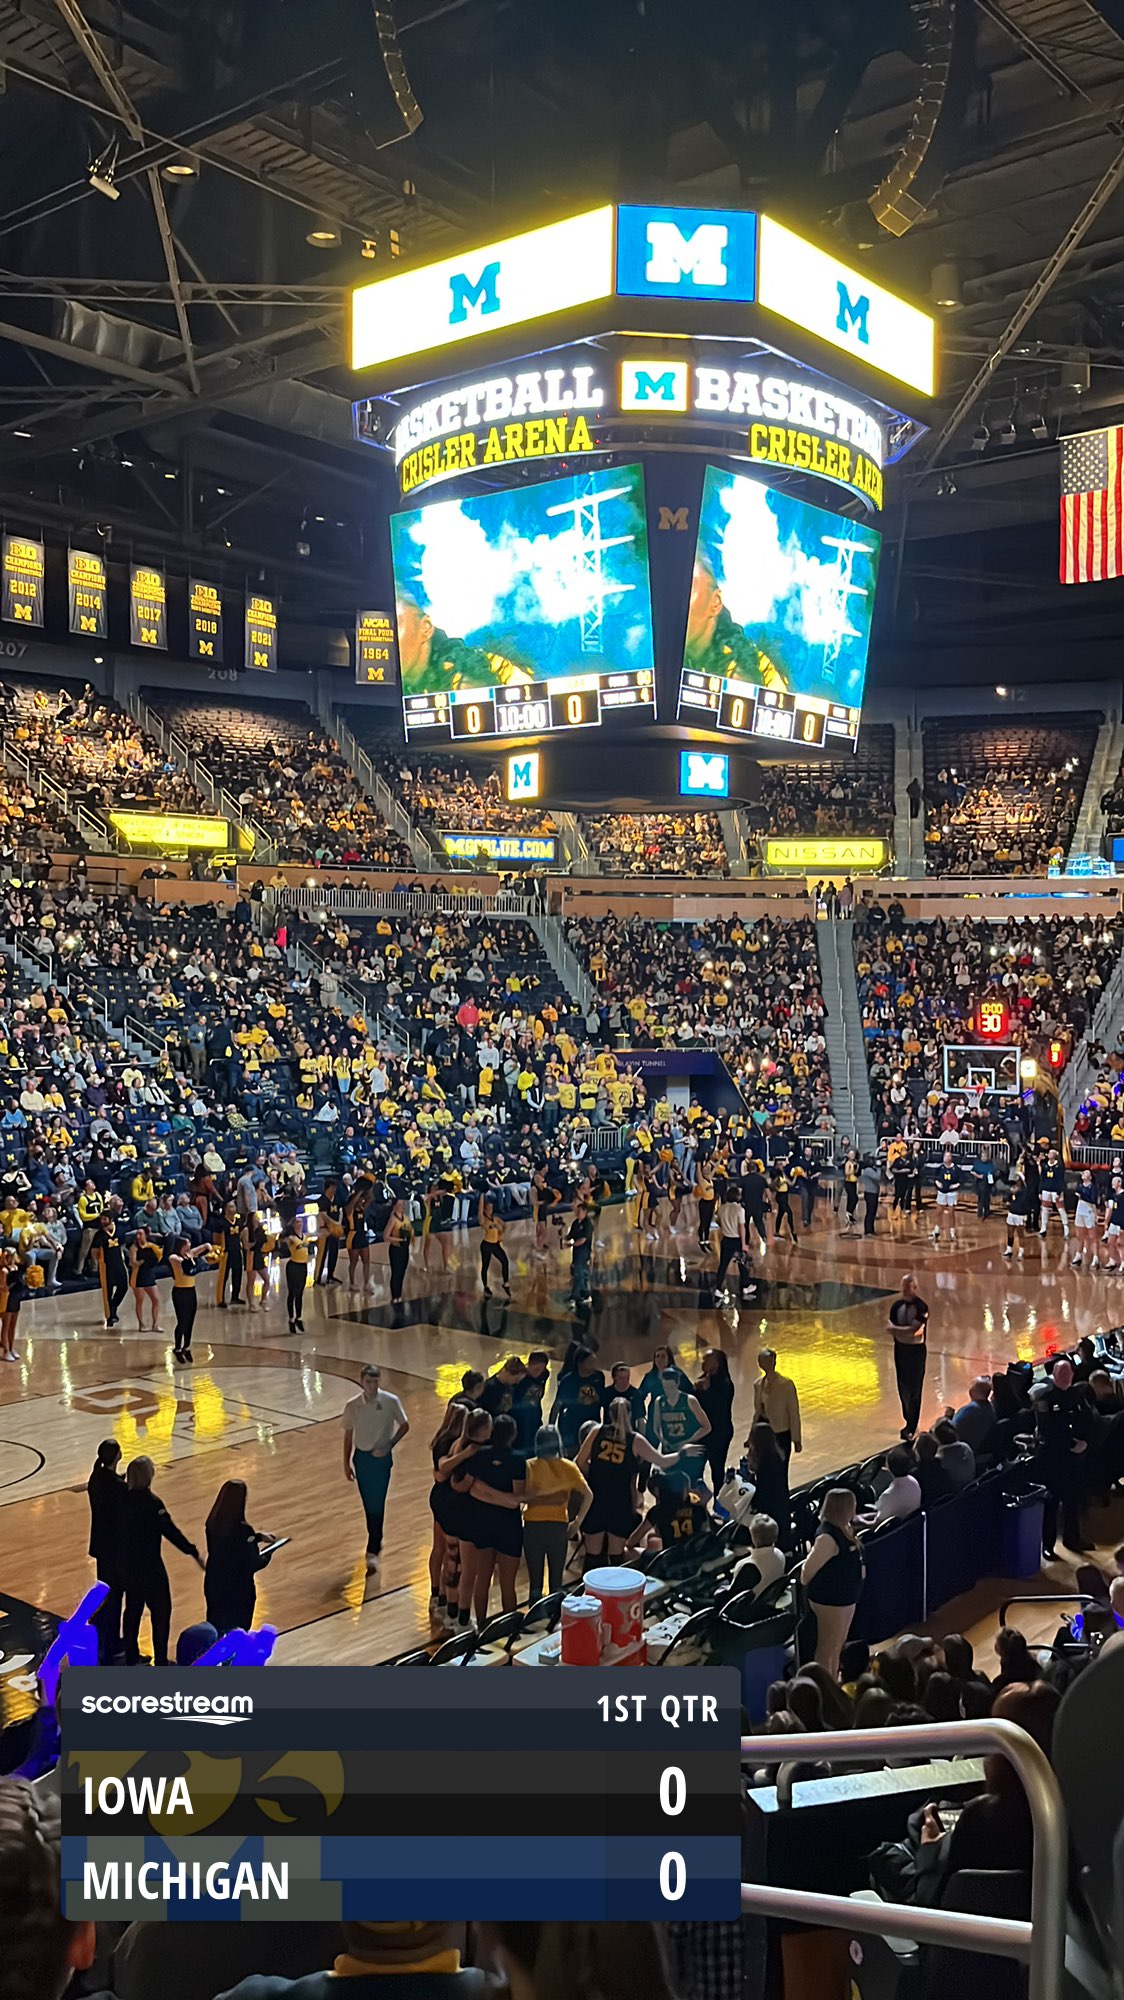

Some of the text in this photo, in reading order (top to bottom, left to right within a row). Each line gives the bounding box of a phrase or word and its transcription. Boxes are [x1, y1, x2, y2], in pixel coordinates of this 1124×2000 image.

[646, 221, 728, 286] M
[449, 261, 500, 324] M
[836, 280, 870, 345] M
[635, 371, 675, 400] M
[402, 416, 594, 493] CRISLER ARENA
[751, 423, 882, 511] CRISLER AREN
[658, 506, 689, 530] M
[10, 580, 37, 598] 2012
[76, 593, 101, 610] 2014
[14, 603, 33, 621] M
[137, 605, 161, 622] 2017
[80, 615, 97, 633] M
[195, 619, 217, 634] 2018
[363, 617, 390, 629] NCAA
[141, 627, 157, 644] M
[251, 631, 272, 647] 2021
[199, 640, 213, 656] M
[364, 647, 389, 660] 1964
[254, 652, 268, 667] M
[367, 668, 384, 681] M
[498, 703, 546, 731] 10:00
[567, 695, 582, 724] 0
[731, 698, 744, 728] 0
[467, 705, 481, 733] 0
[804, 714, 816, 741] 0
[513, 761, 531, 788] M
[688, 755, 725, 790] M
[774, 847, 875, 859] NISSAN
[981, 1003, 1004, 1014] 10:00
[981, 1014, 1001, 1032] 30
[666, 1423, 685, 1437] 22
[598, 1440, 627, 1465] 25
[671, 1519, 693, 1538] 14
